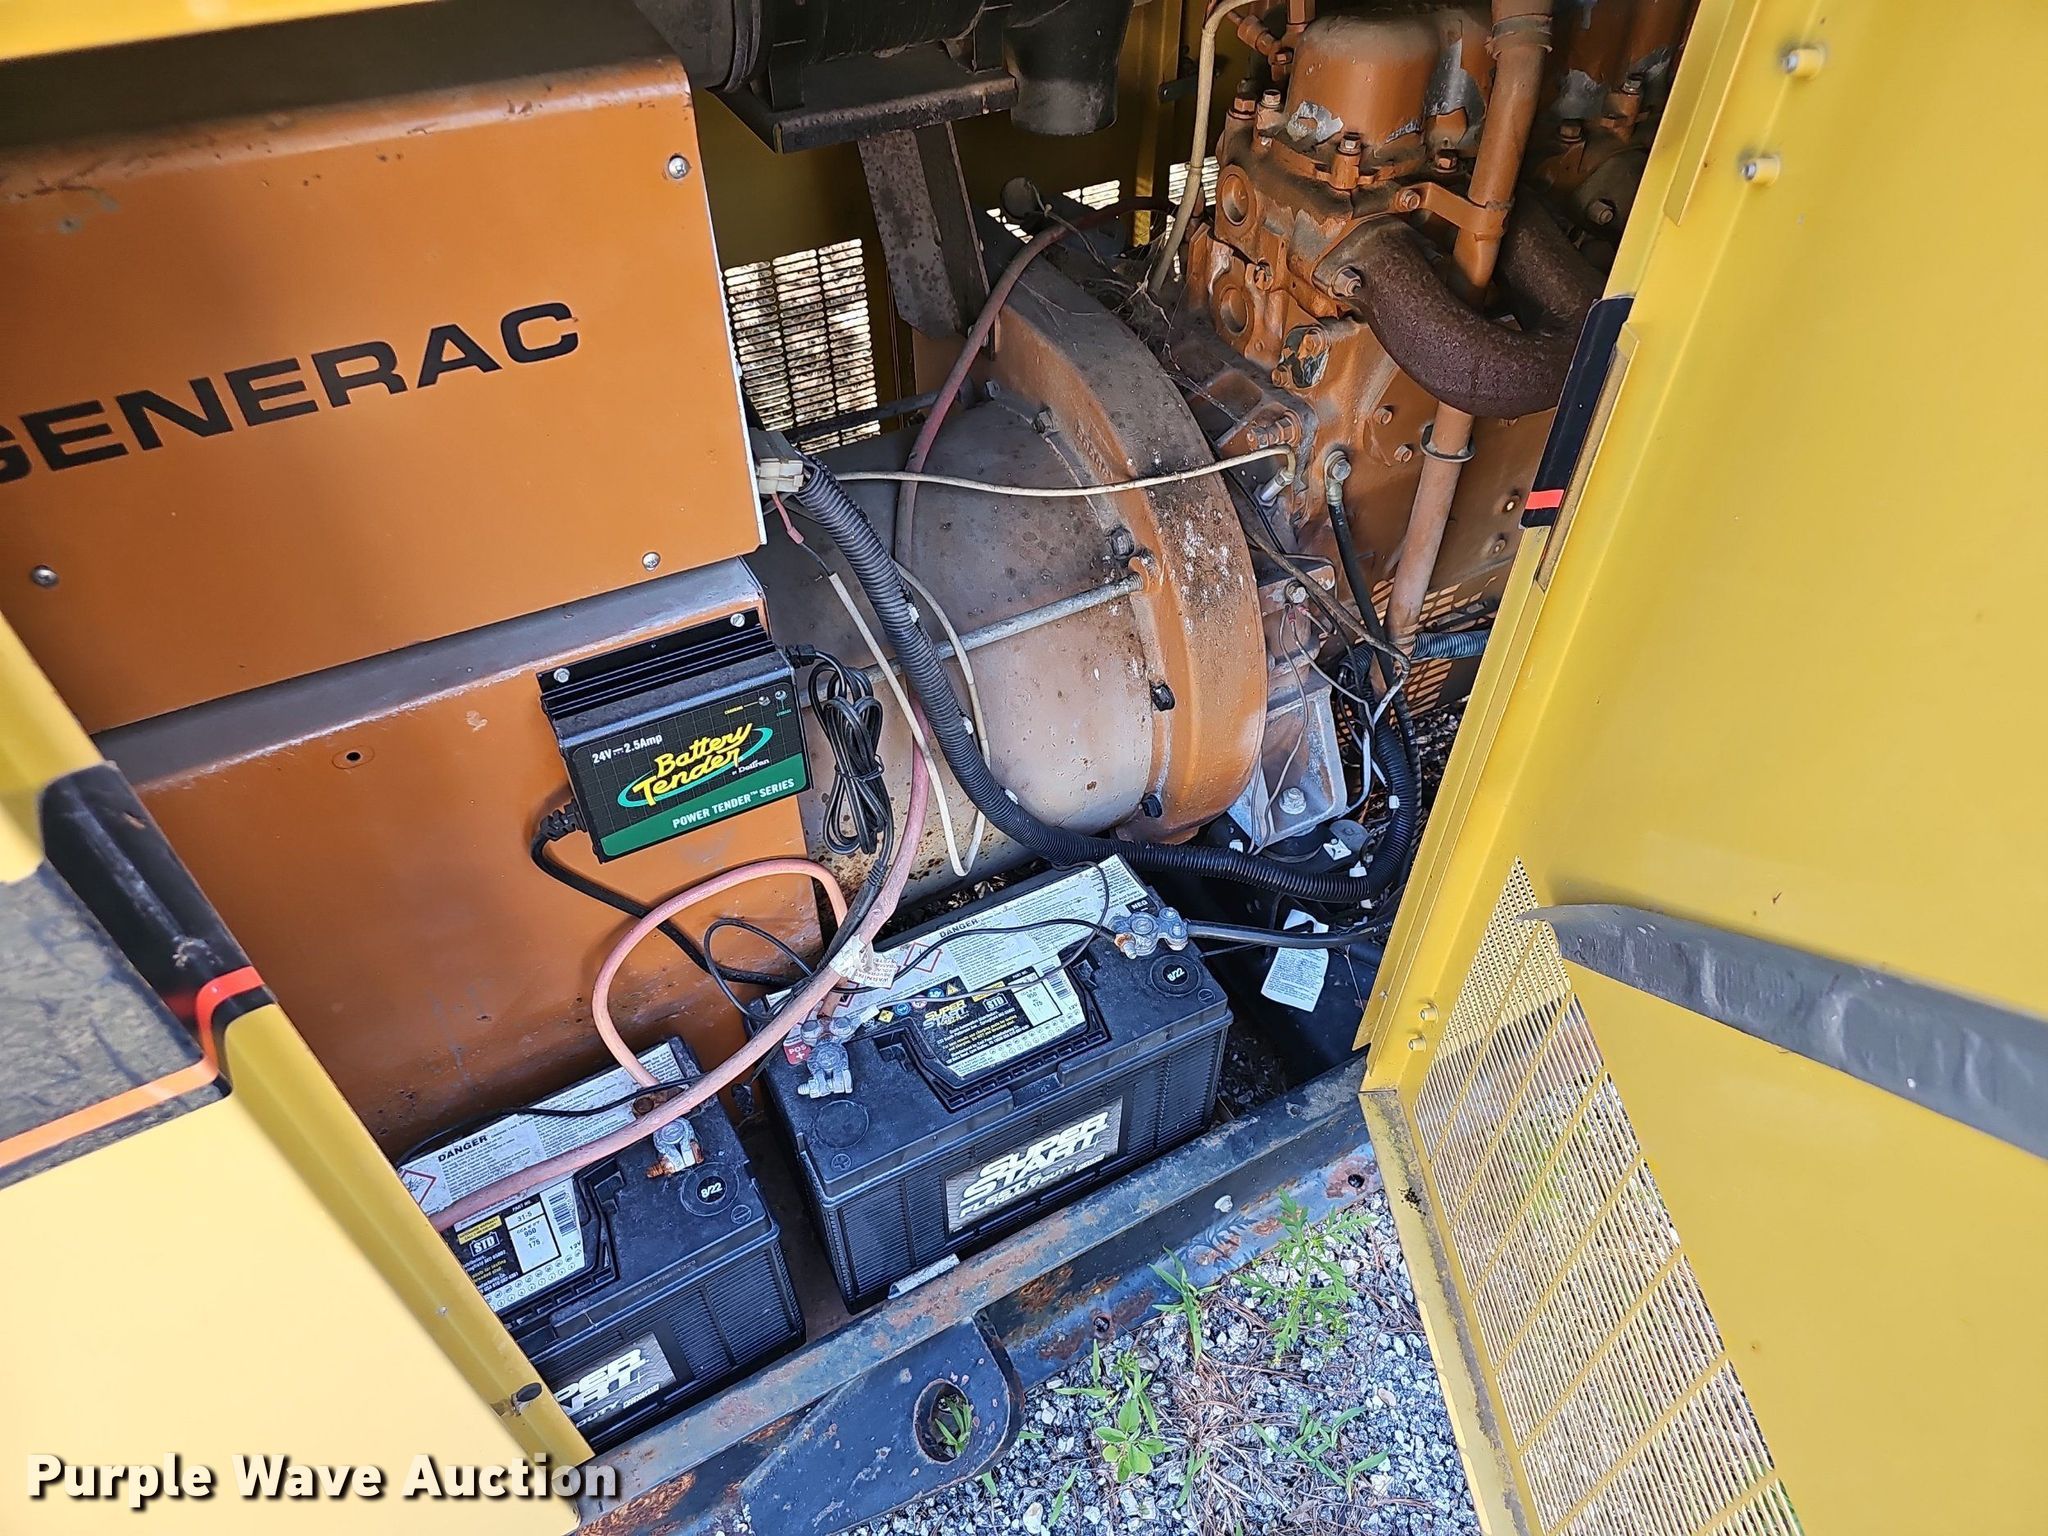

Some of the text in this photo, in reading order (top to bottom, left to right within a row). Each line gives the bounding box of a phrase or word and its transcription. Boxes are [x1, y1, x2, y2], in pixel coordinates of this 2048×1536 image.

[655, 723, 753, 778] Battery
[632, 748, 741, 807] Tender
[672, 808, 710, 829] POWER
[759, 778, 795, 798] SERIES
[1131, 900, 1149, 910] NEG
[939, 919, 979, 938] DANGER
[1167, 967, 1185, 982] 8/22
[925, 1000, 965, 1020] SUPER
[985, 998, 1005, 1009] STD
[437, 1135, 488, 1162] DANGER
[980, 1112, 1109, 1178] SUPER
[959, 1125, 1109, 1207] START
[1041, 1162, 1077, 1183] DUTY
[700, 1181, 723, 1199] 8/22
[517, 1211, 533, 1222] 31-5
[523, 1227, 537, 1238] 950
[474, 1237, 496, 1254] STD
[528, 1240, 541, 1249] 175
[569, 1242, 582, 1251] 12V
[554, 1349, 642, 1402] PER
[576, 1399, 622, 1428] DUTY
